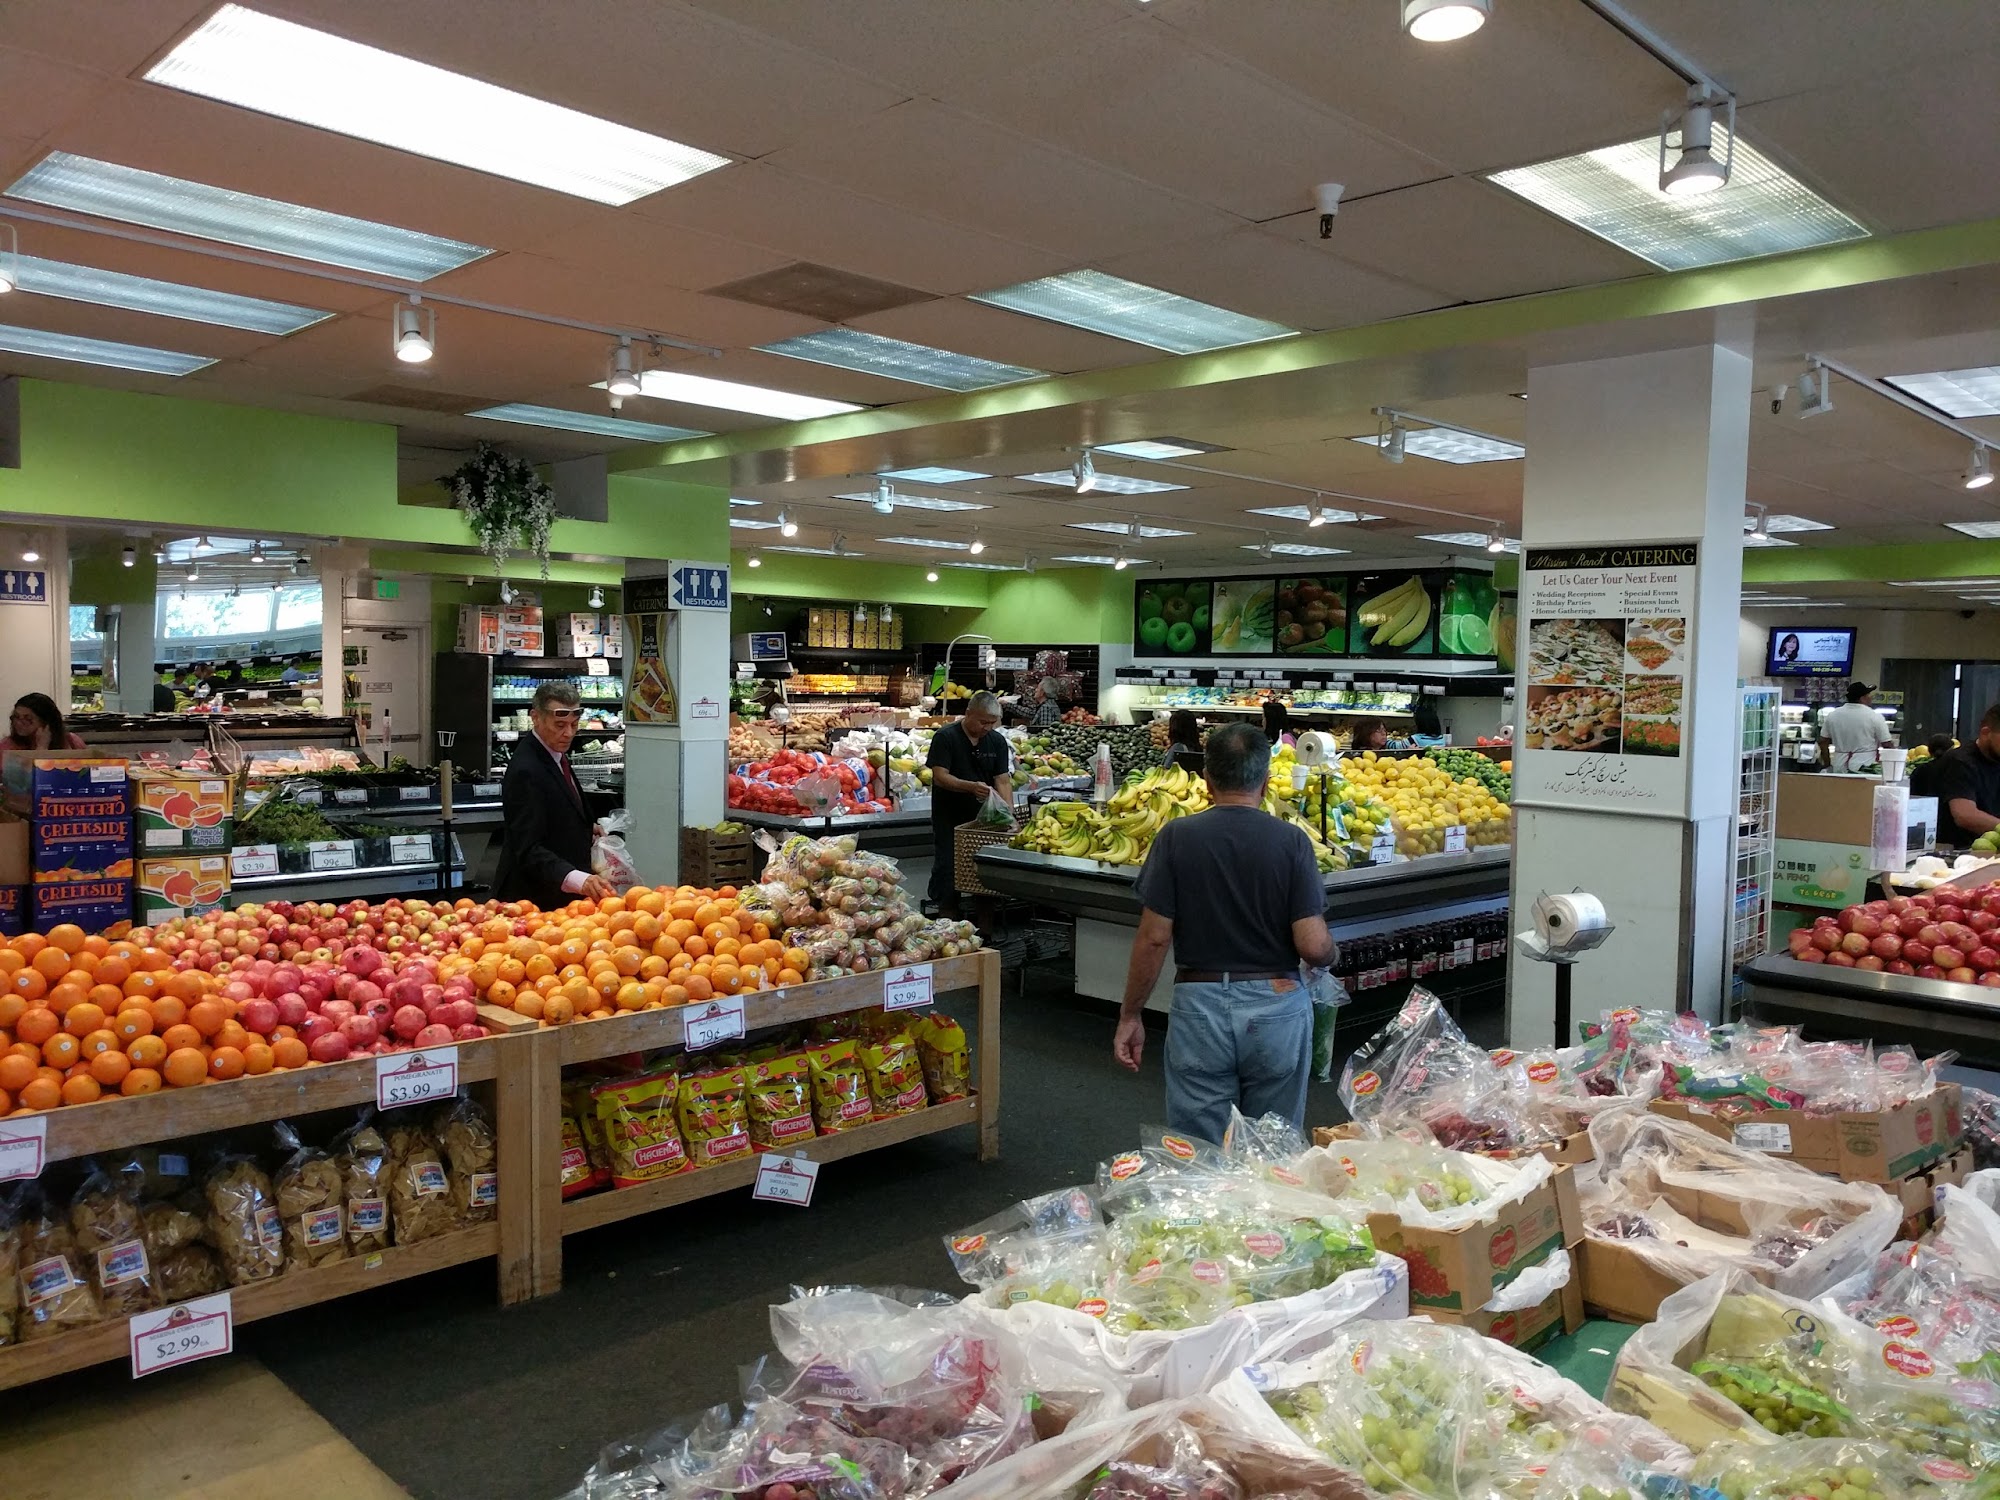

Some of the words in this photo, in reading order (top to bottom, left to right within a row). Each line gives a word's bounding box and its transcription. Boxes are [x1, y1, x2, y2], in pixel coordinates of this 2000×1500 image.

[1529, 554, 1568, 568] Mission
[1571, 551, 1607, 567] Ranch
[1611, 548, 1695, 567] CATERING
[1542, 575, 1557, 586] Let
[1559, 574, 1571, 585] Us
[1573, 573, 1598, 585] Cater
[1601, 573, 1623, 584] Your
[1624, 572, 1647, 584] Next
[1649, 572, 1677, 583] Event
[1536, 590, 1566, 599] Wedding
[1567, 590, 1606, 599] Receptions
[1624, 589, 1651, 597] Special
[633, 598, 668, 610] CATERING
[685, 597, 726, 607] RESTROOMS
[1557, 607, 1596, 616] Gatherings
[1623, 607, 1653, 615] Holiday
[38, 801, 126, 817] CREEKSIDE
[40, 821, 128, 838] CREEKSIDE
[192, 827, 224, 837] Minneola
[192, 836, 224, 846] Tangelos
[241, 862, 265, 872] $2.39
[38, 882, 126, 902] CREEKSIDE
[893, 990, 917, 1005] $2.99
[699, 1028, 720, 1044] 79¢
[394, 1068, 443, 1081] POMEGRANATE
[1529, 1069, 1541, 1078] Del
[1541, 1066, 1557, 1075] Monte
[389, 1082, 431, 1102] $3.99
[776, 1119, 810, 1133] HACIENDA
[711, 1135, 747, 1153] HACIENDA
[639, 1142, 680, 1162] HACIENDA
[633, 1163, 665, 1177] Tortilla
[769, 1186, 789, 1197] $2.99
[176, 1324, 196, 1334] CORN
[196, 1320, 215, 1329] CHIPS
[156, 1334, 201, 1359] $2.99
[1886, 1349, 1903, 1361] Del
[1901, 1353, 1932, 1369] Monte
